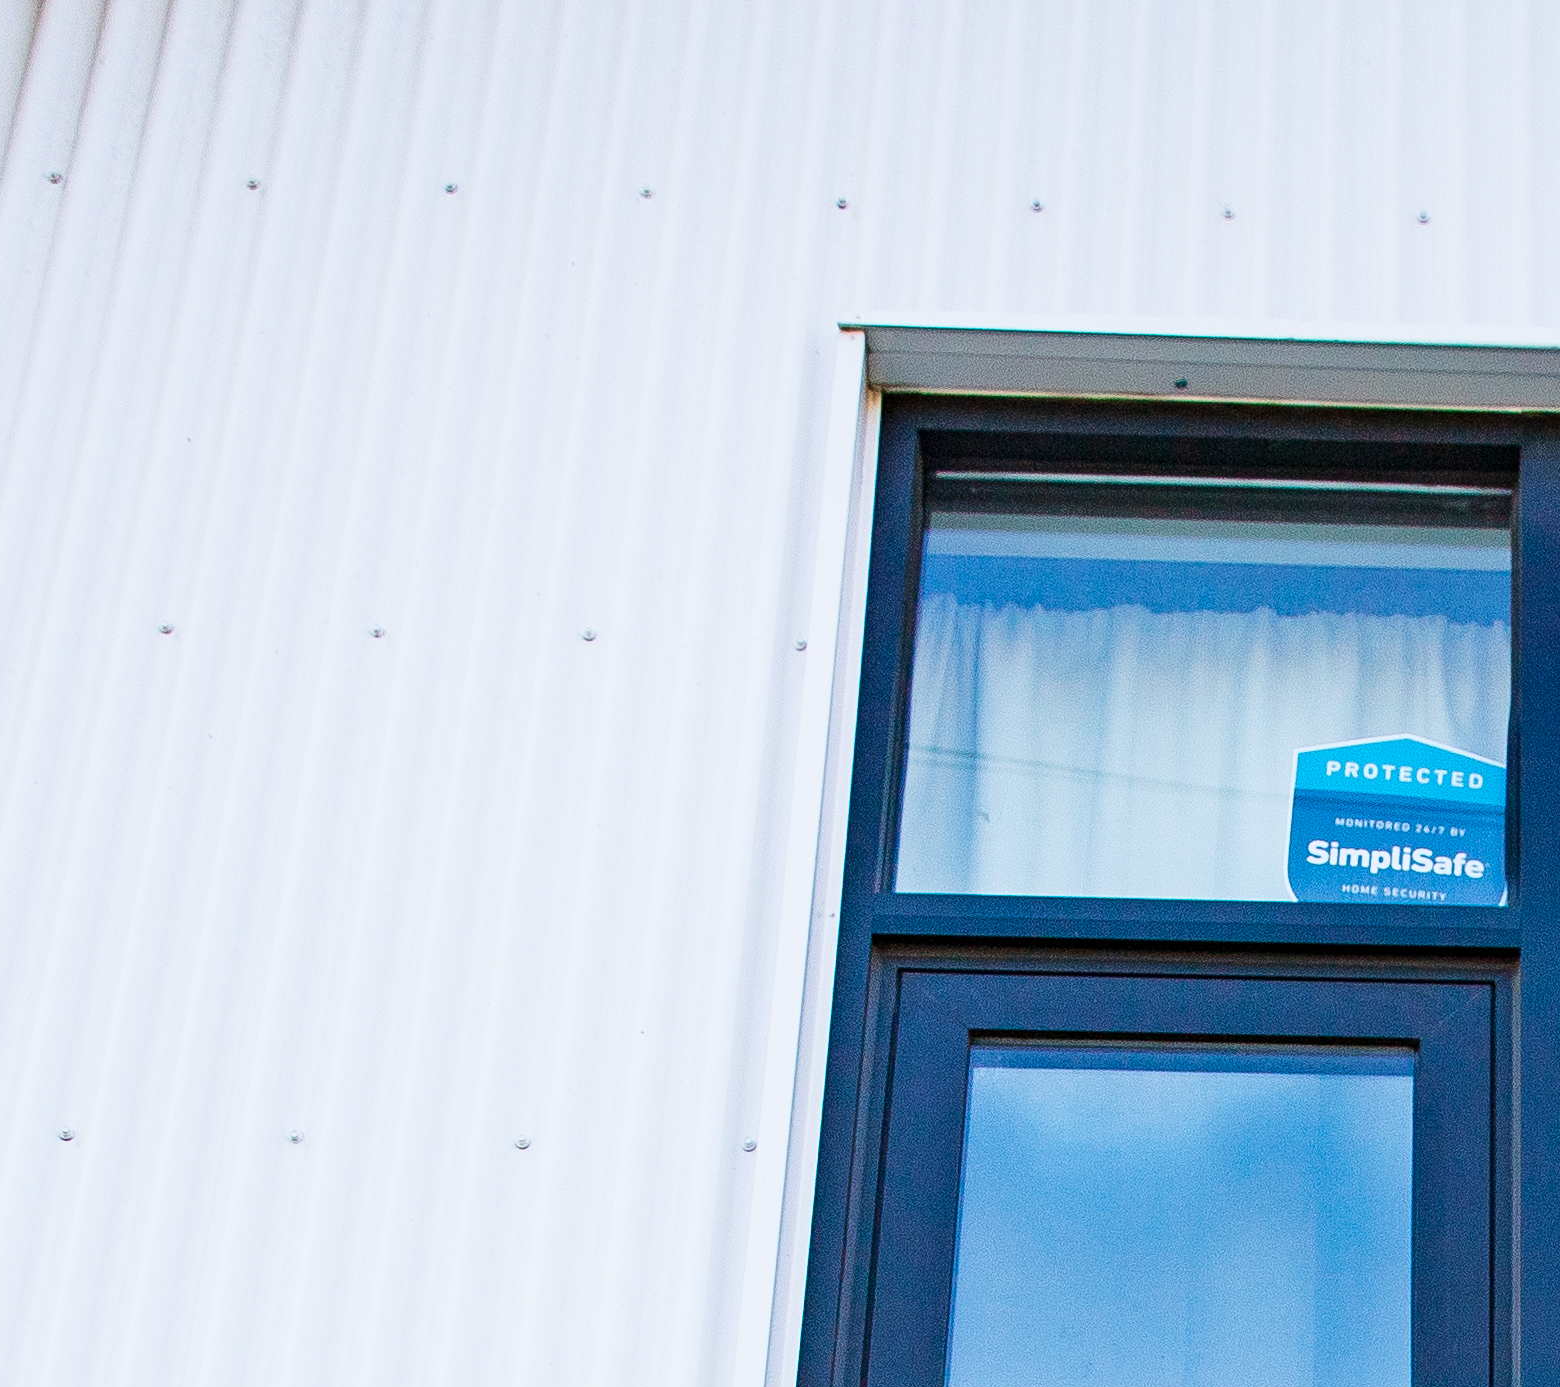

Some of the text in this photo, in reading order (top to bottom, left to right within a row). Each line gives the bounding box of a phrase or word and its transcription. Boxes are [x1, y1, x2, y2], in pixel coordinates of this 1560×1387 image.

[1325, 760, 1485, 790] PROTECTED
[1334, 817, 1466, 838] MONITORED 24/7 BY
[1306, 839, 1486, 879] SimpliSafe
[1341, 883, 1447, 901] HOME SECURITY
